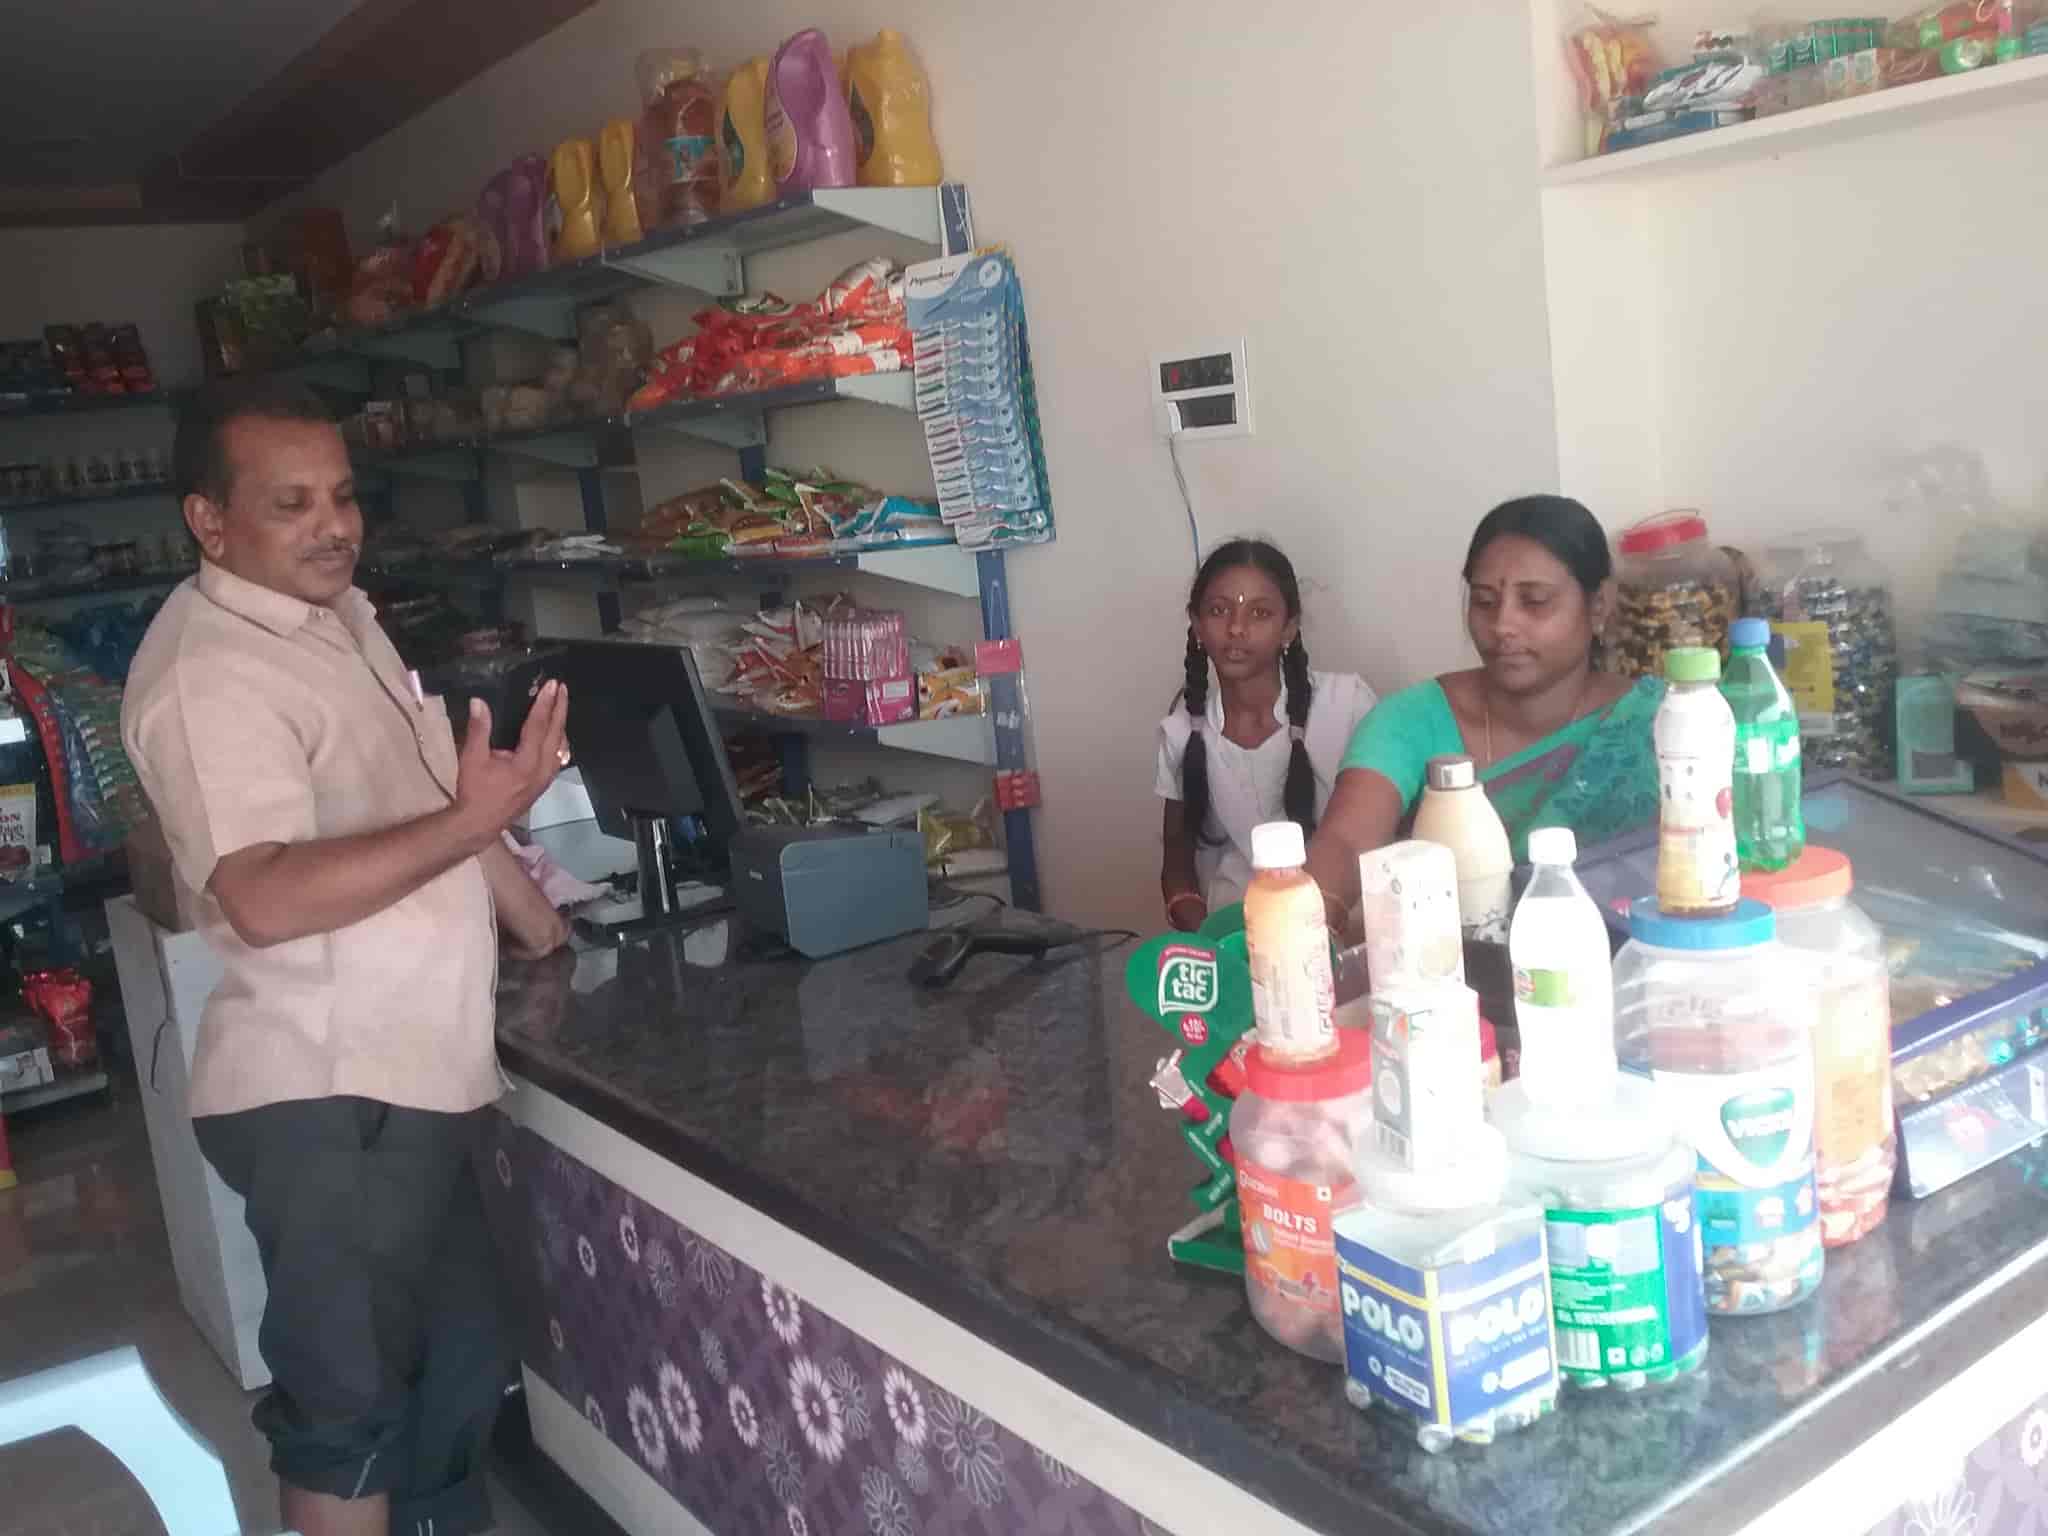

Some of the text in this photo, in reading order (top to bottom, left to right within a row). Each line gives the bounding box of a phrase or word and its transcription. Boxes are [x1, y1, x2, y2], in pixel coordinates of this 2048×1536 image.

[1179, 962, 1208, 986] tic
[1171, 978, 1208, 1002] tac
[1263, 1202, 1318, 1233] BOLTS
[1341, 1280, 1425, 1351] POLO
[1449, 1287, 1545, 1356] POLO
